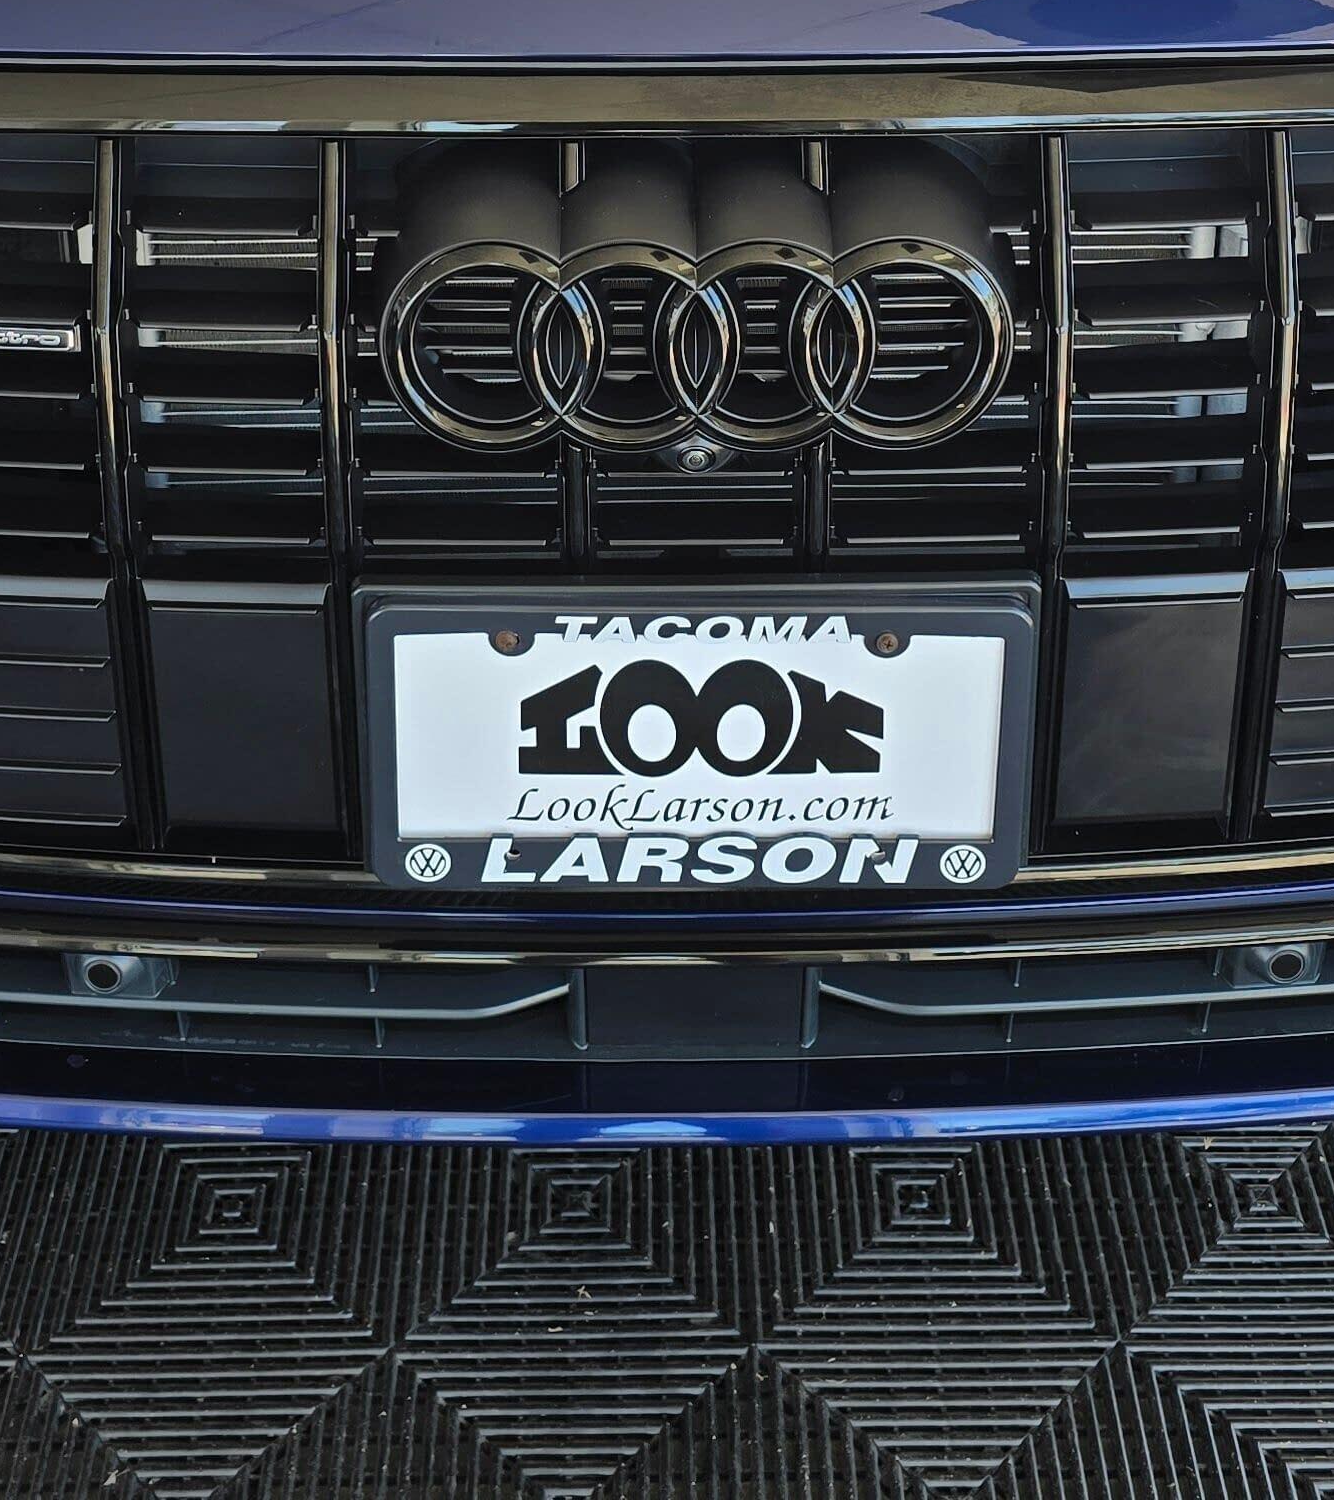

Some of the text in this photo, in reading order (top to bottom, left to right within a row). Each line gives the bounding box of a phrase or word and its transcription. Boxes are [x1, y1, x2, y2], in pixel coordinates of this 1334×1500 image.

[554, 615, 854, 644] TACOMA
[518, 659, 885, 777] LOOK
[506, 784, 894, 831] LookLarson.com
[480, 836, 920, 884] LARSON
